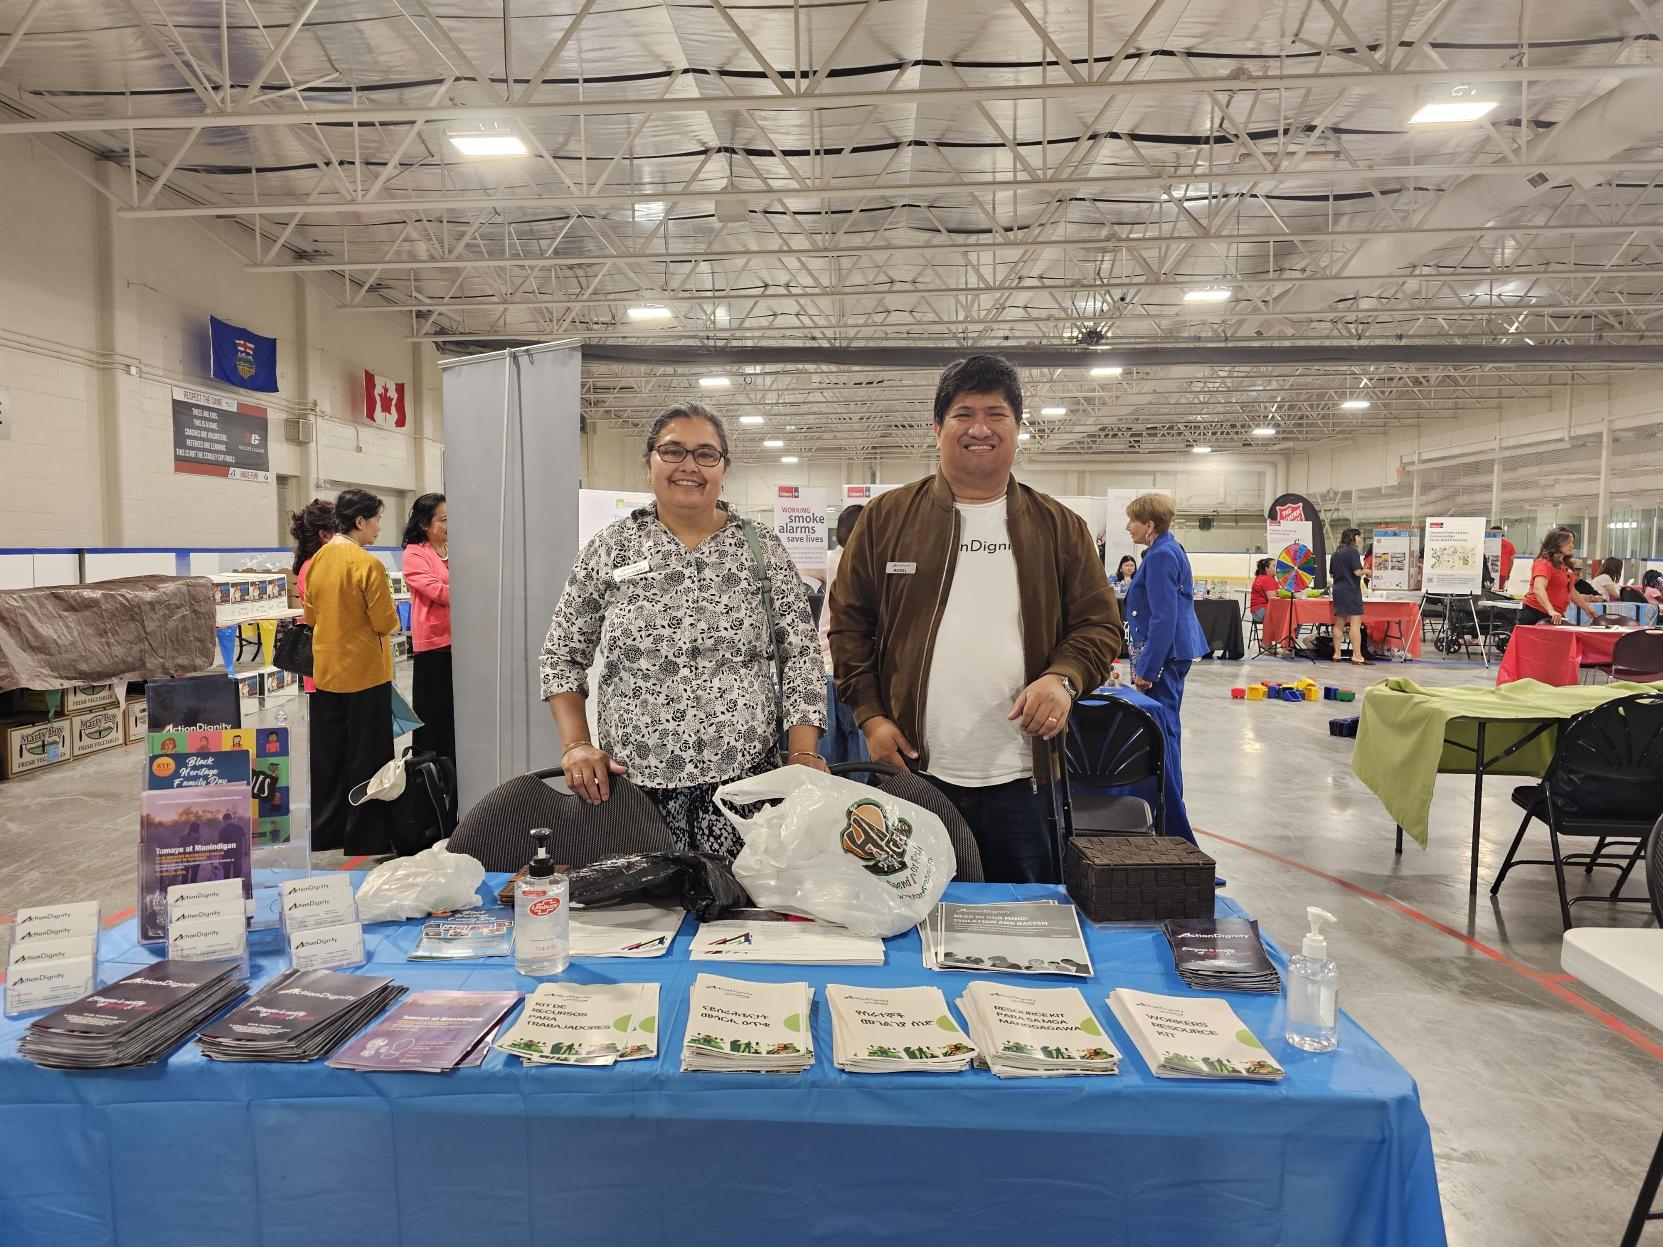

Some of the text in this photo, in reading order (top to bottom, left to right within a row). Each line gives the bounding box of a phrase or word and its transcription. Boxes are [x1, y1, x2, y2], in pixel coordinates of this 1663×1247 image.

[788, 512, 825, 524] smoke
[778, 522, 816, 534] alarms
[806, 534, 824, 543] lives
[88, 694, 113, 704] VEGETABLES
[80, 713, 117, 730] Marty Boy
[163, 722, 232, 733] ActionDignity
[20, 726, 64, 745] Marty Boy
[78, 737, 120, 752] FRESH VEGETABLES
[18, 760, 36, 768] FRESH
[186, 756, 214, 767] Black
[180, 768, 219, 778] Heritage
[174, 776, 228, 788] Family Day
[155, 846, 184, 855] Tumayo
[194, 842, 236, 853] Manindigan
[278, 988, 358, 1000] ActionDignity
[532, 1008, 588, 1017] RECURSOS
[994, 1006, 1049, 1018] RESOURCE
[996, 1012, 1026, 1021] PARA
[526, 1022, 610, 1030] TRABAJADORES
[999, 1018, 1082, 1031] MANGGAGAWA
[1145, 1014, 1208, 1027] WORKERS
[1151, 1022, 1220, 1036] RESOURCE
